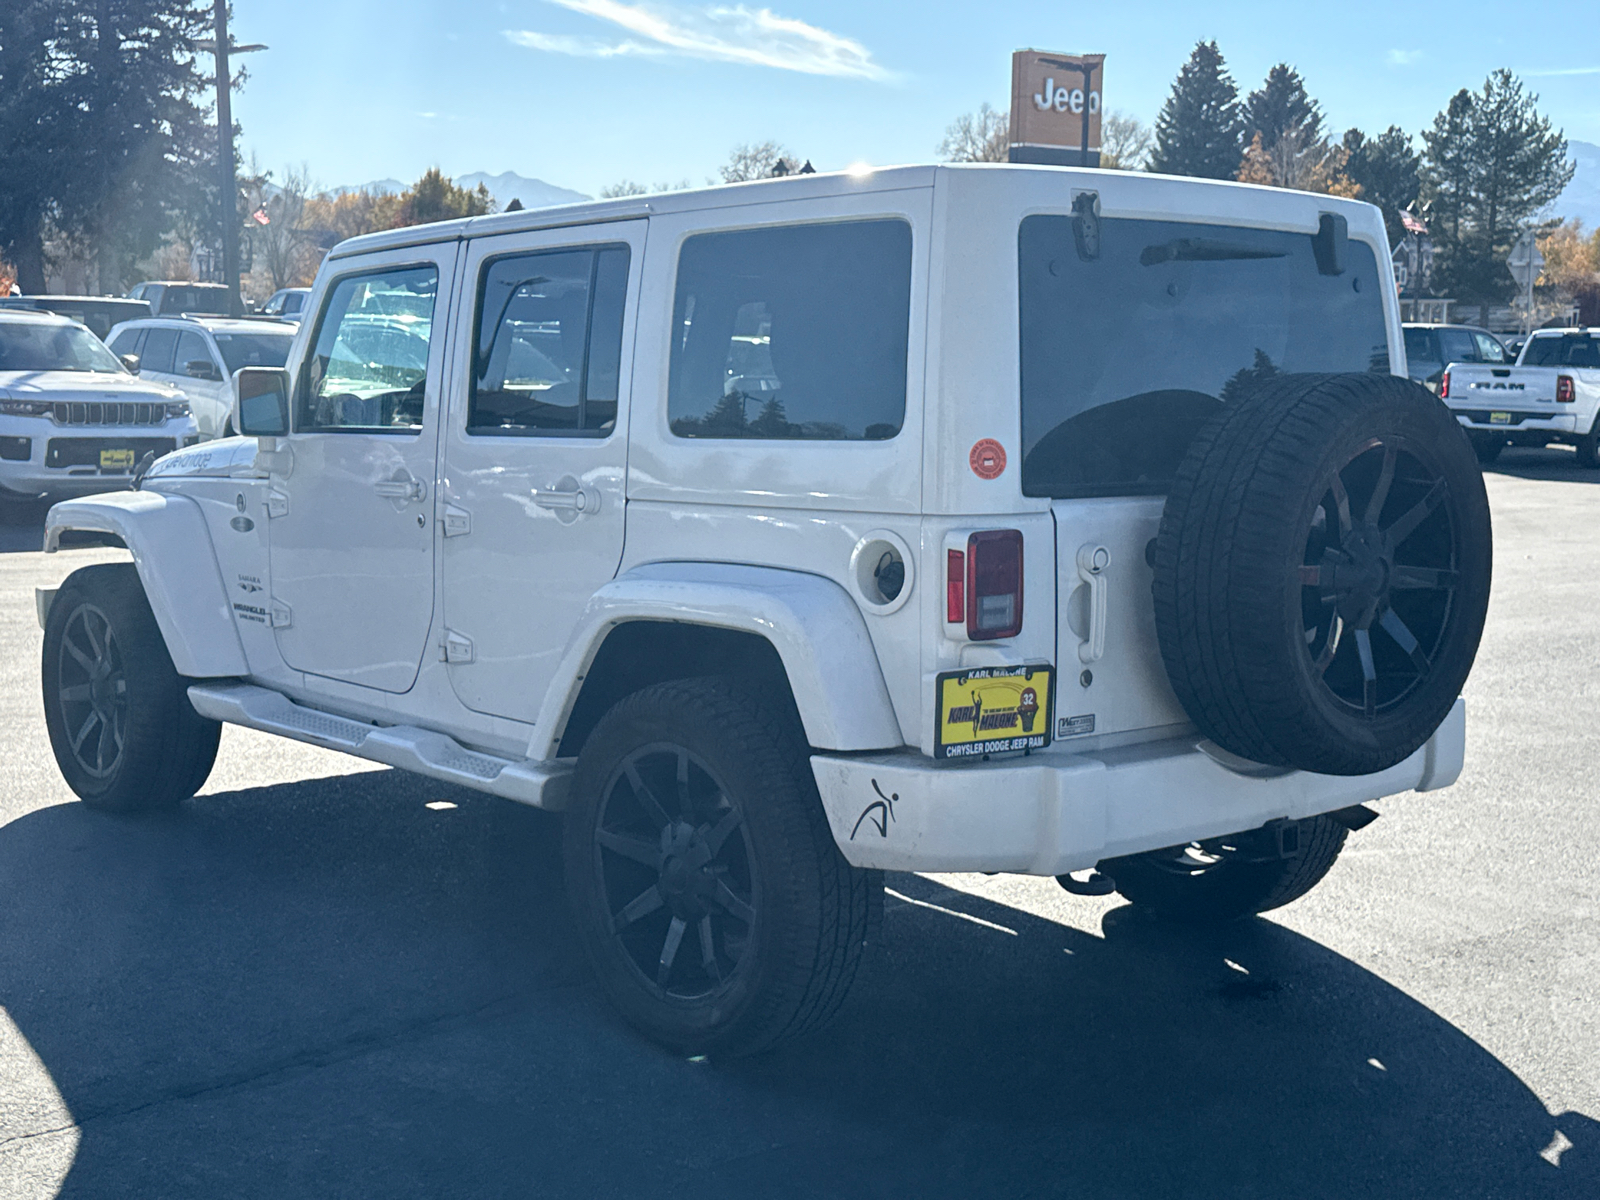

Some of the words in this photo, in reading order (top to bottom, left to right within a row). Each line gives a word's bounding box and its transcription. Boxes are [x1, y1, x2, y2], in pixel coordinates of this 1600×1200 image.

[1034, 77, 1100, 115] Jeep
[1472, 382, 1525, 390] RAM
[968, 671, 991, 679] KARL
[1023, 693, 1034, 706] 32
[947, 705, 975, 724] KARL
[979, 711, 1019, 731] MALONE
[946, 740, 985, 757] CHRYSLER
[985, 739, 1010, 753] DODGE
[1010, 737, 1027, 750] JEEP
[1028, 736, 1044, 747] RAM
